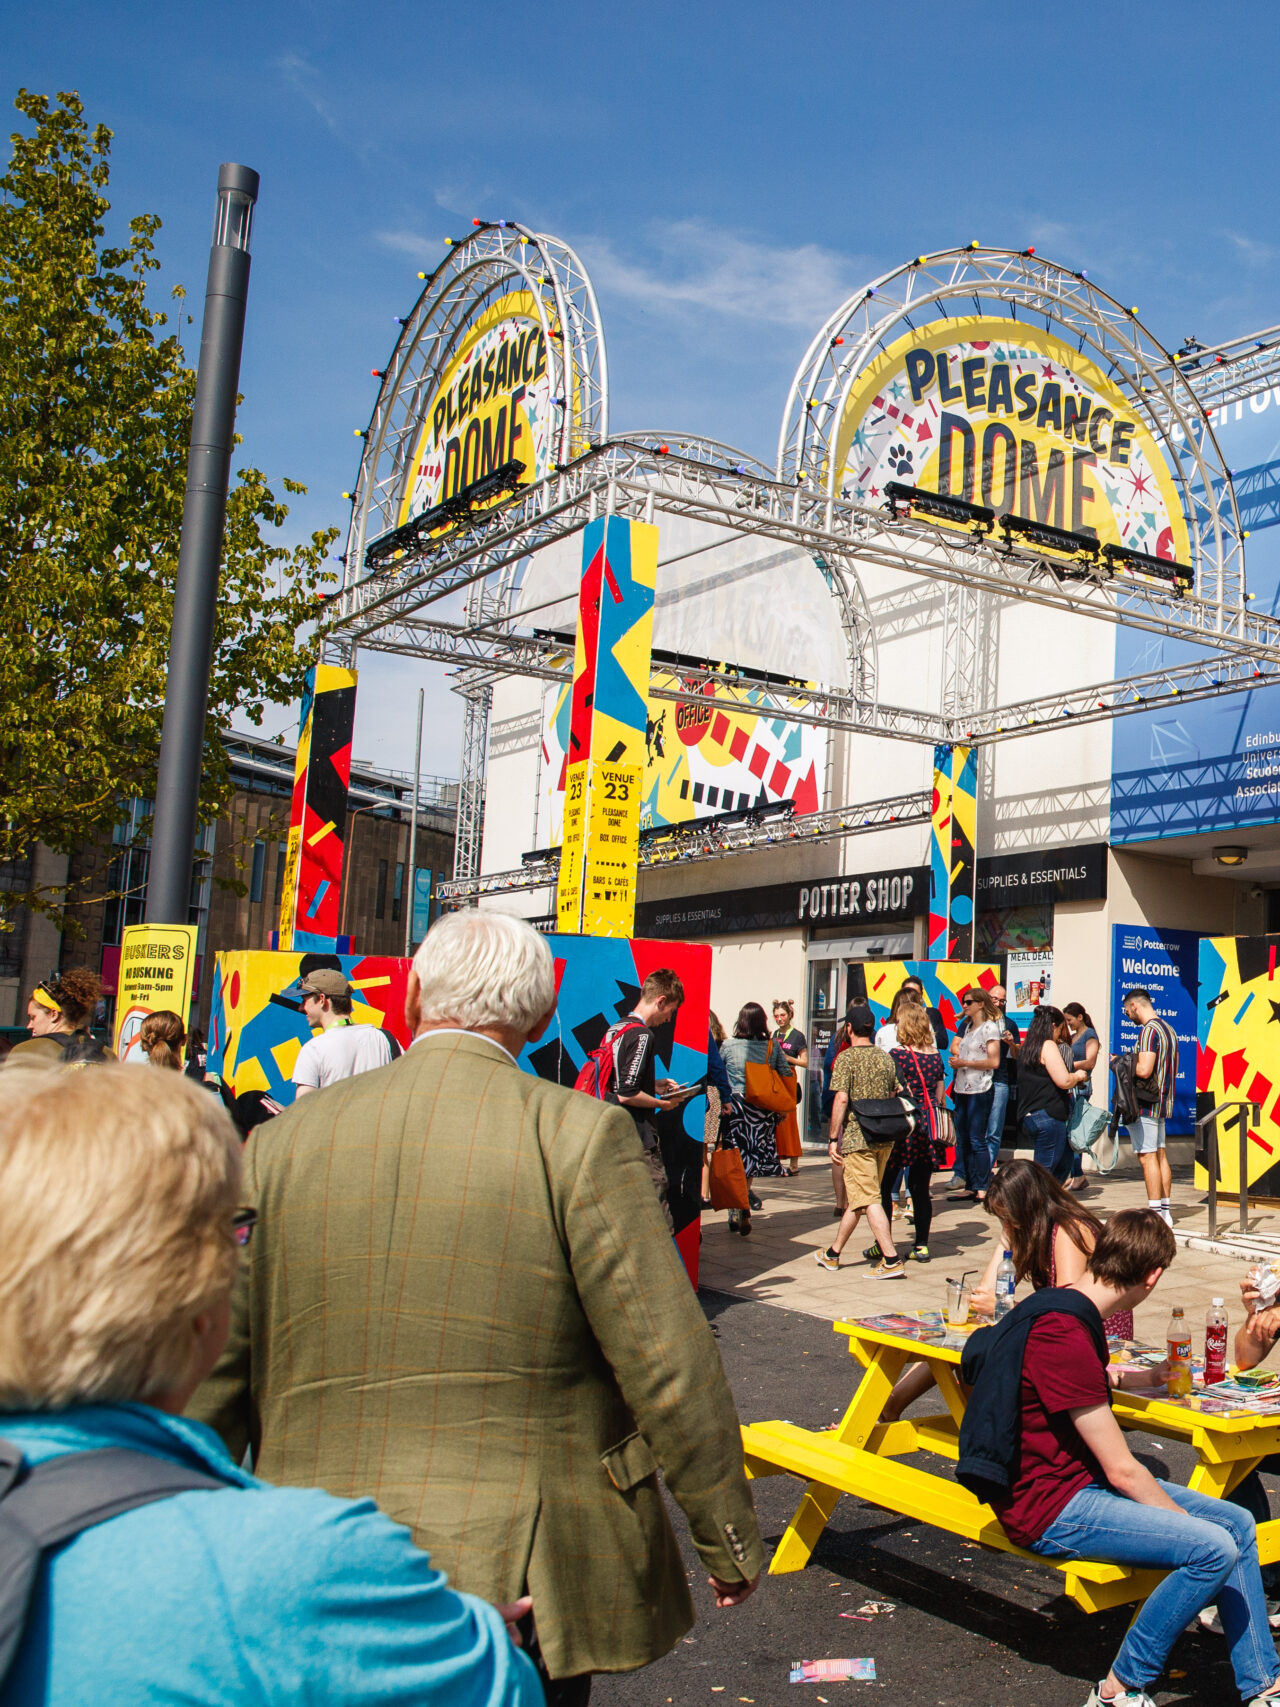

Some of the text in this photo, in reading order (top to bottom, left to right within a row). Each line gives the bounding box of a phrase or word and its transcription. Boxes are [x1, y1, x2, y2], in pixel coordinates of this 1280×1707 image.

[432, 325, 547, 450] PLEASANCE
[905, 348, 1136, 467] PLEASANCE
[938, 411, 1098, 539] DOME
[677, 703, 711, 731] OFFICE
[602, 771, 635, 784] VENUE
[570, 782, 582, 800] 23
[604, 782, 629, 801] 23
[602, 807, 628, 818] PLEASANCE
[608, 817, 621, 827] DOME
[600, 833, 628, 844] BOX OFFICE
[593, 876, 605, 885] BARS
[977, 866, 1087, 890] SUPPLIES & ESSENTIALS
[799, 874, 914, 919] POTTER SHOP
[655, 907, 722, 925] SUPPLIES & ESSENTIALS
[124, 944, 184, 960] BUSKERS
[1144, 940, 1180, 951] Potterrow
[1010, 952, 1031, 962] MEAL
[132, 967, 174, 979] BUSKING
[1122, 958, 1180, 977] Welcome
[1122, 982, 1164, 991] Activities Office
